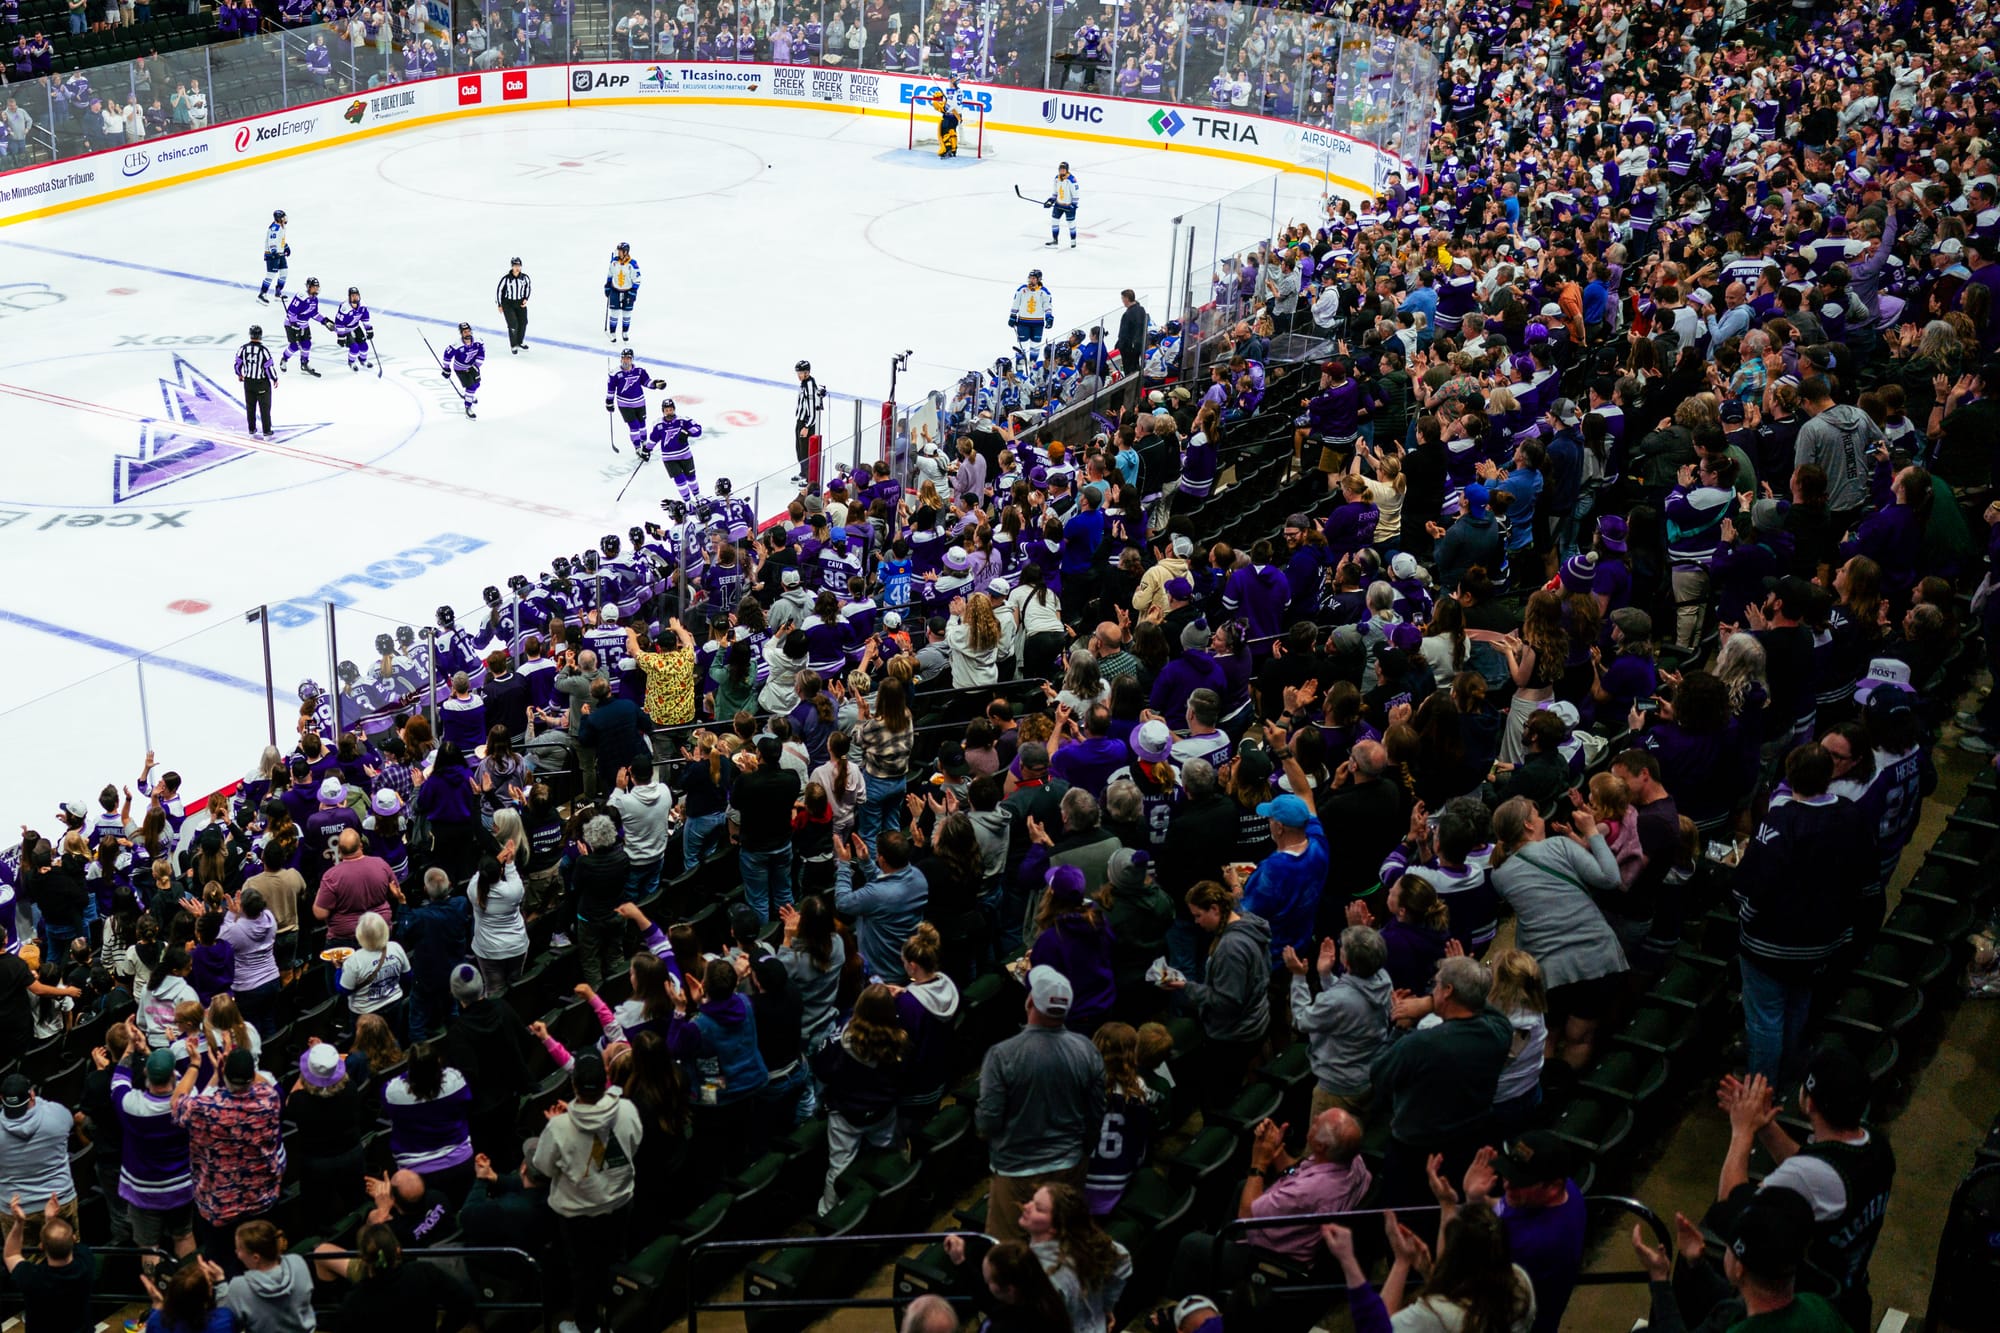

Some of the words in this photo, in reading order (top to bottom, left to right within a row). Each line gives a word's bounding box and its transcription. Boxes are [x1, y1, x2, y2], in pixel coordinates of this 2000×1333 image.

[681, 69, 761, 81] TIcasino.com
[774, 68, 805, 79] WOODY
[813, 70, 843, 82] WOODY
[850, 73, 879, 86] WOODY
[462, 86, 477, 96] Cub
[507, 81, 523, 91] Cub
[774, 79, 805, 89] CREEK
[812, 81, 842, 92] CREEK
[849, 85, 878, 96] CREEK
[773, 88, 805, 96] DISTILLERS
[812, 91, 843, 99] DISTILLERS
[900, 83, 992, 112] ECOAB
[371, 98, 380, 112] THE
[381, 94, 399, 110] HOCKEY
[400, 91, 415, 106] LODGE
[849, 95, 879, 104] DISTILLERS
[1061, 103, 1103, 123] UHC
[256, 123, 281, 141] Xcel
[282, 118, 316, 135] Energy
[1192, 117, 1259, 145] TRIA
[1301, 131, 1352, 155] AIRSUPRA
[124, 151, 148, 168] CHS
[157, 144, 208, 162] chsinc.com
[11, 182, 51, 200] Minnesota
[51, 177, 68, 191] Star
[67, 171, 95, 187] Tribune
[111, 332, 239, 347] Xcel
[35, 510, 193, 531] Xcel
[825, 560, 844, 570] CAVA
[264, 532, 492, 628] ECOLAB
[890, 583, 912, 606] 48
[749, 632, 767, 644] HEISE
[1870, 666, 1897, 680] ROST
[1211, 747, 1230, 767] HEISE
[1893, 757, 1919, 783] HEISE
[320, 823, 346, 836] PRINCE
[412, 1203, 446, 1241] FROST
